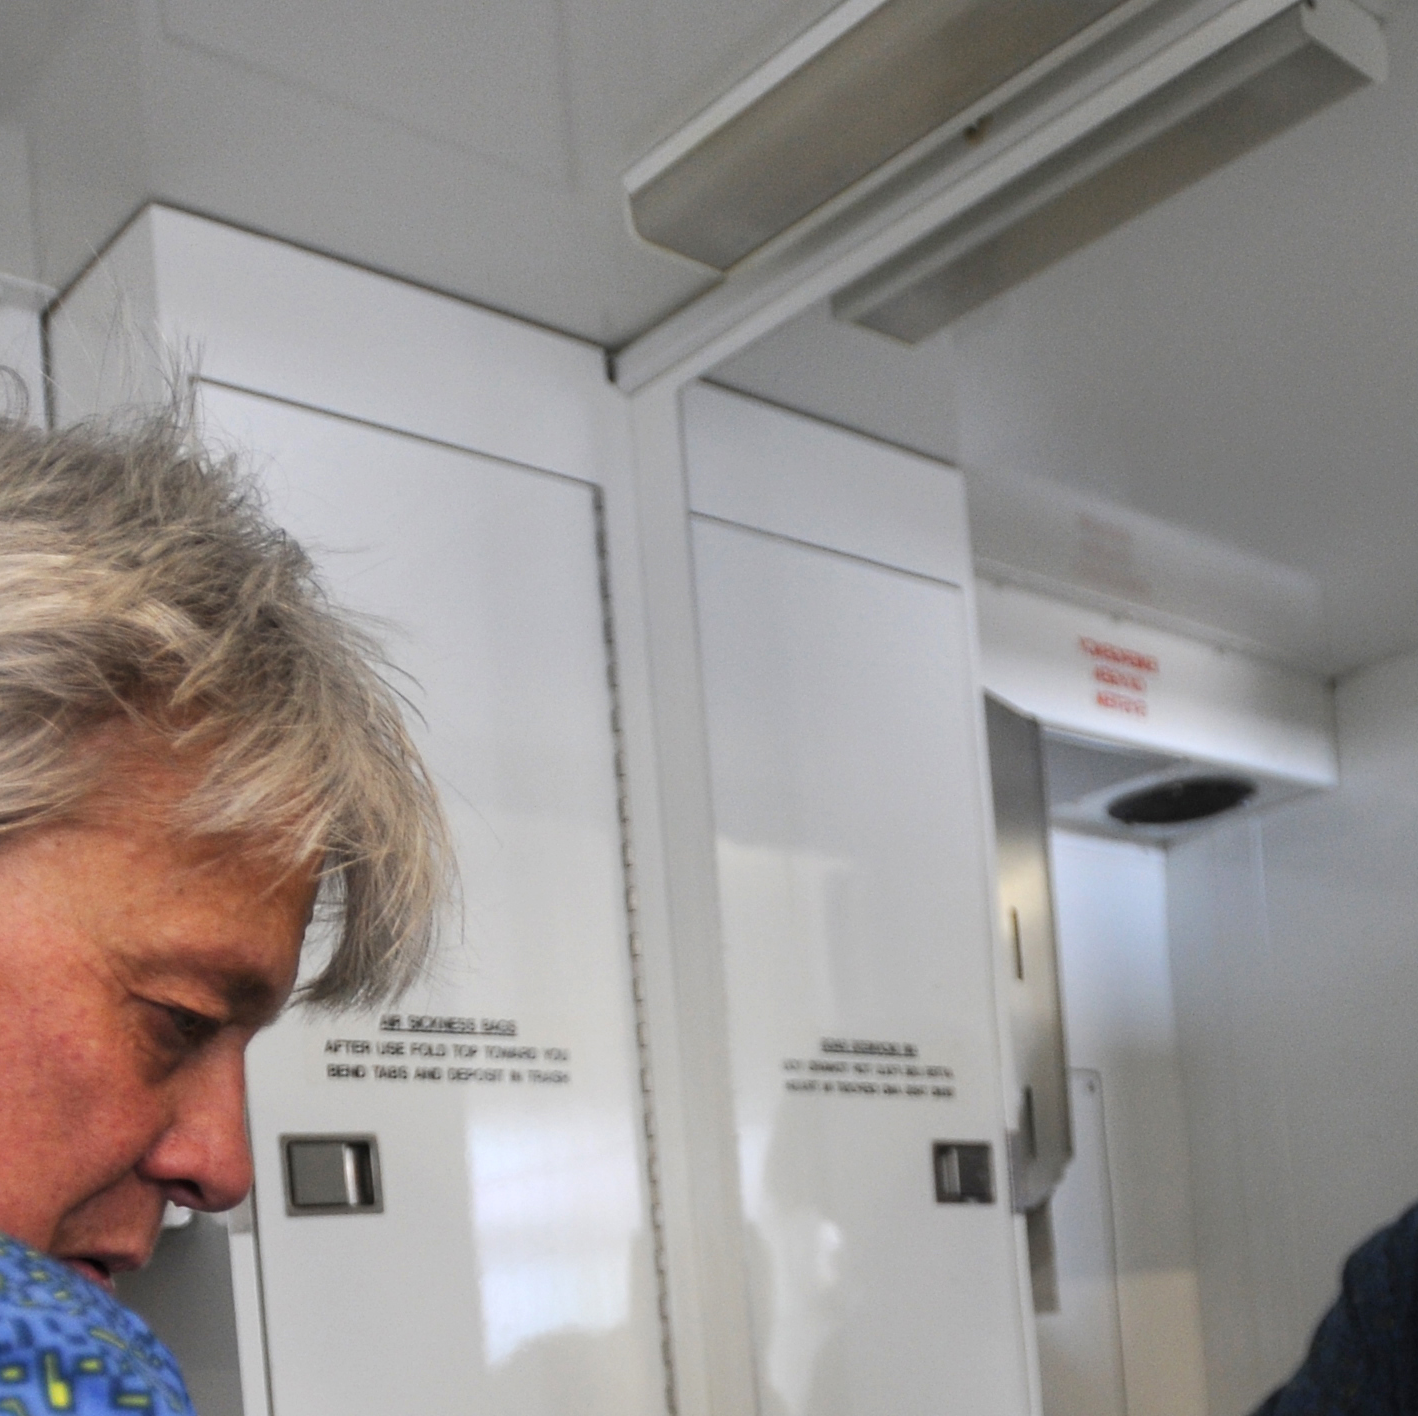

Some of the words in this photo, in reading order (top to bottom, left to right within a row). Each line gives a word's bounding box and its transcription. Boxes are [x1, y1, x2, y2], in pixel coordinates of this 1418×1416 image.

[407, 1015, 475, 1031] SICKNESS
[482, 1018, 517, 1033] BAGS
[325, 1039, 371, 1054] AFTER
[376, 1041, 404, 1055] USE
[410, 1042, 446, 1057] FOLD
[453, 1044, 477, 1059] TOP
[543, 1047, 569, 1061] YOU
[327, 1064, 366, 1079] BEND
[373, 1065, 407, 1079] TABS
[413, 1066, 441, 1080] AND
[447, 1067, 503, 1082] DEPOSIT
